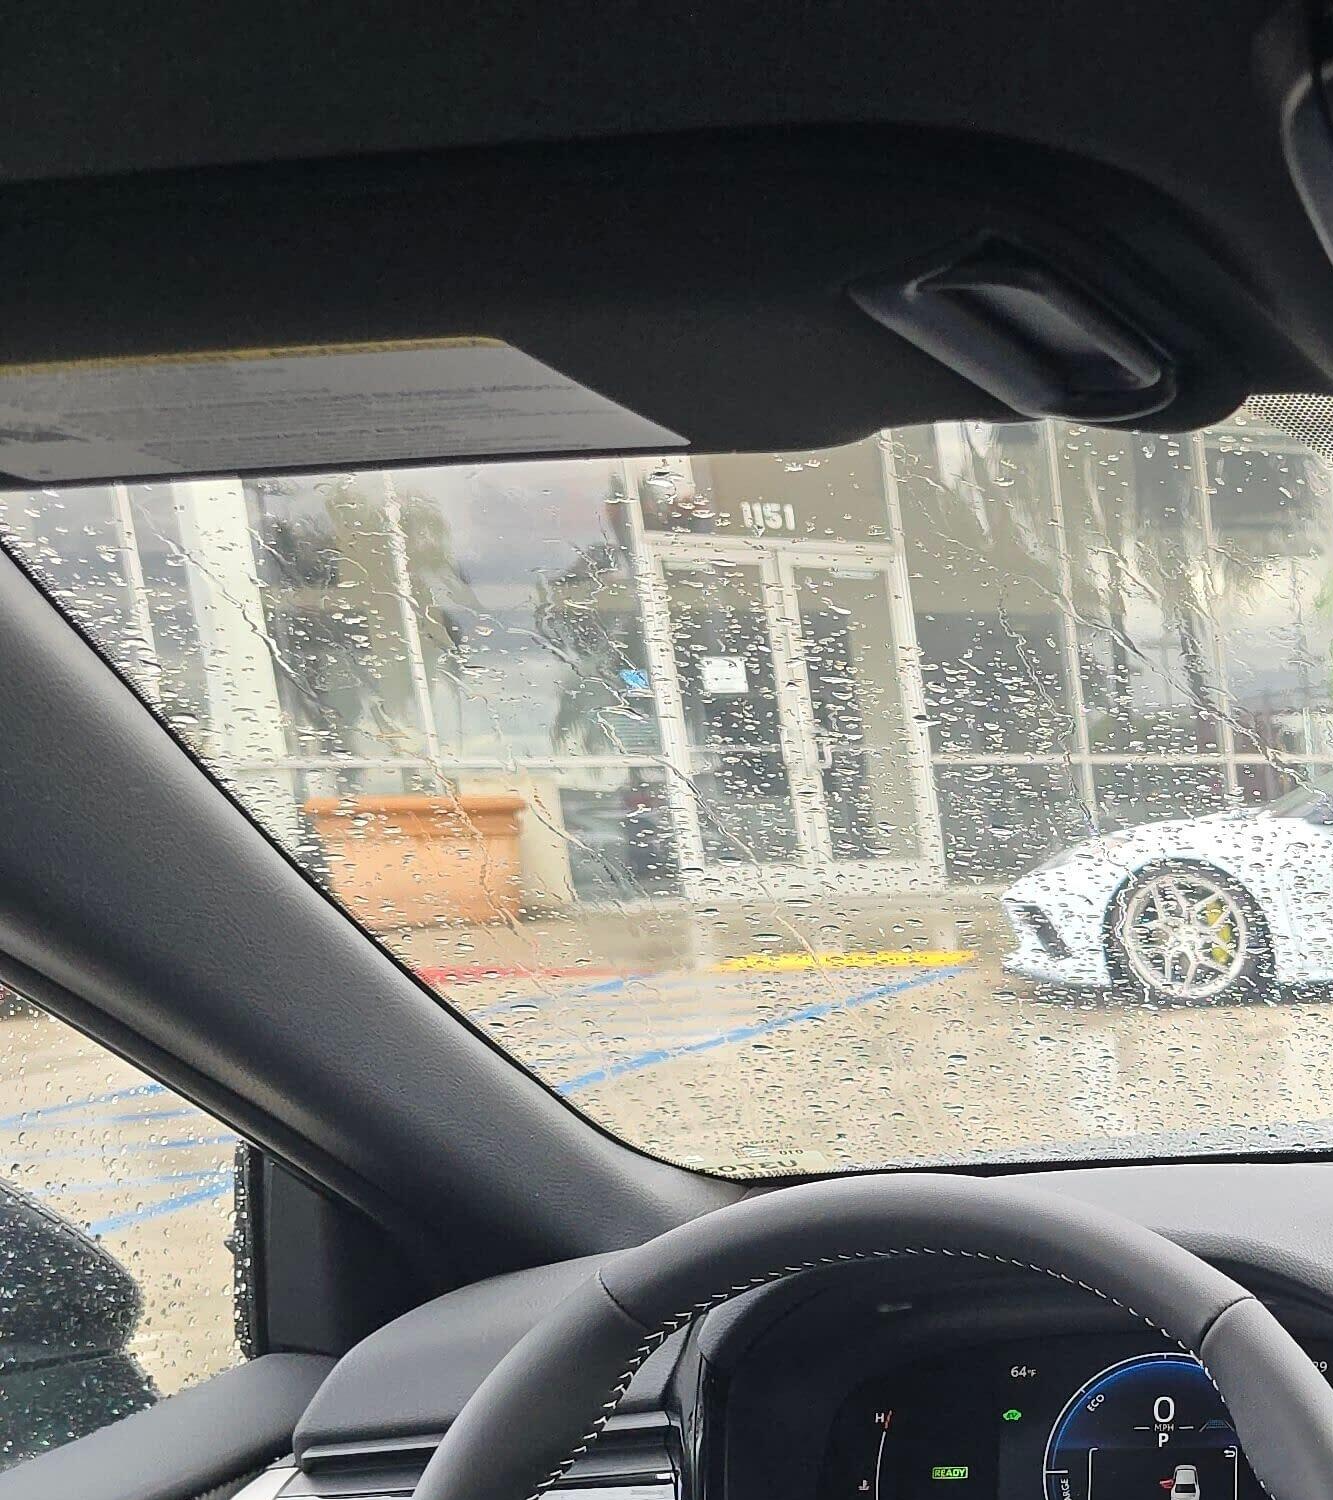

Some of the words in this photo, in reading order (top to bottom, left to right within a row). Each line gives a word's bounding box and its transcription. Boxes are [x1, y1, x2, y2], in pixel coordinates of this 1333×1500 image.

[740, 501, 795, 530] 1151
[1086, 1394, 1105, 1412] ECO
[1153, 1396, 1175, 1422] 0
[874, 1413, 885, 1422] H
[1154, 1424, 1174, 1432] MPH
[1158, 1433, 1170, 1448] P
[934, 1468, 966, 1478] READY
